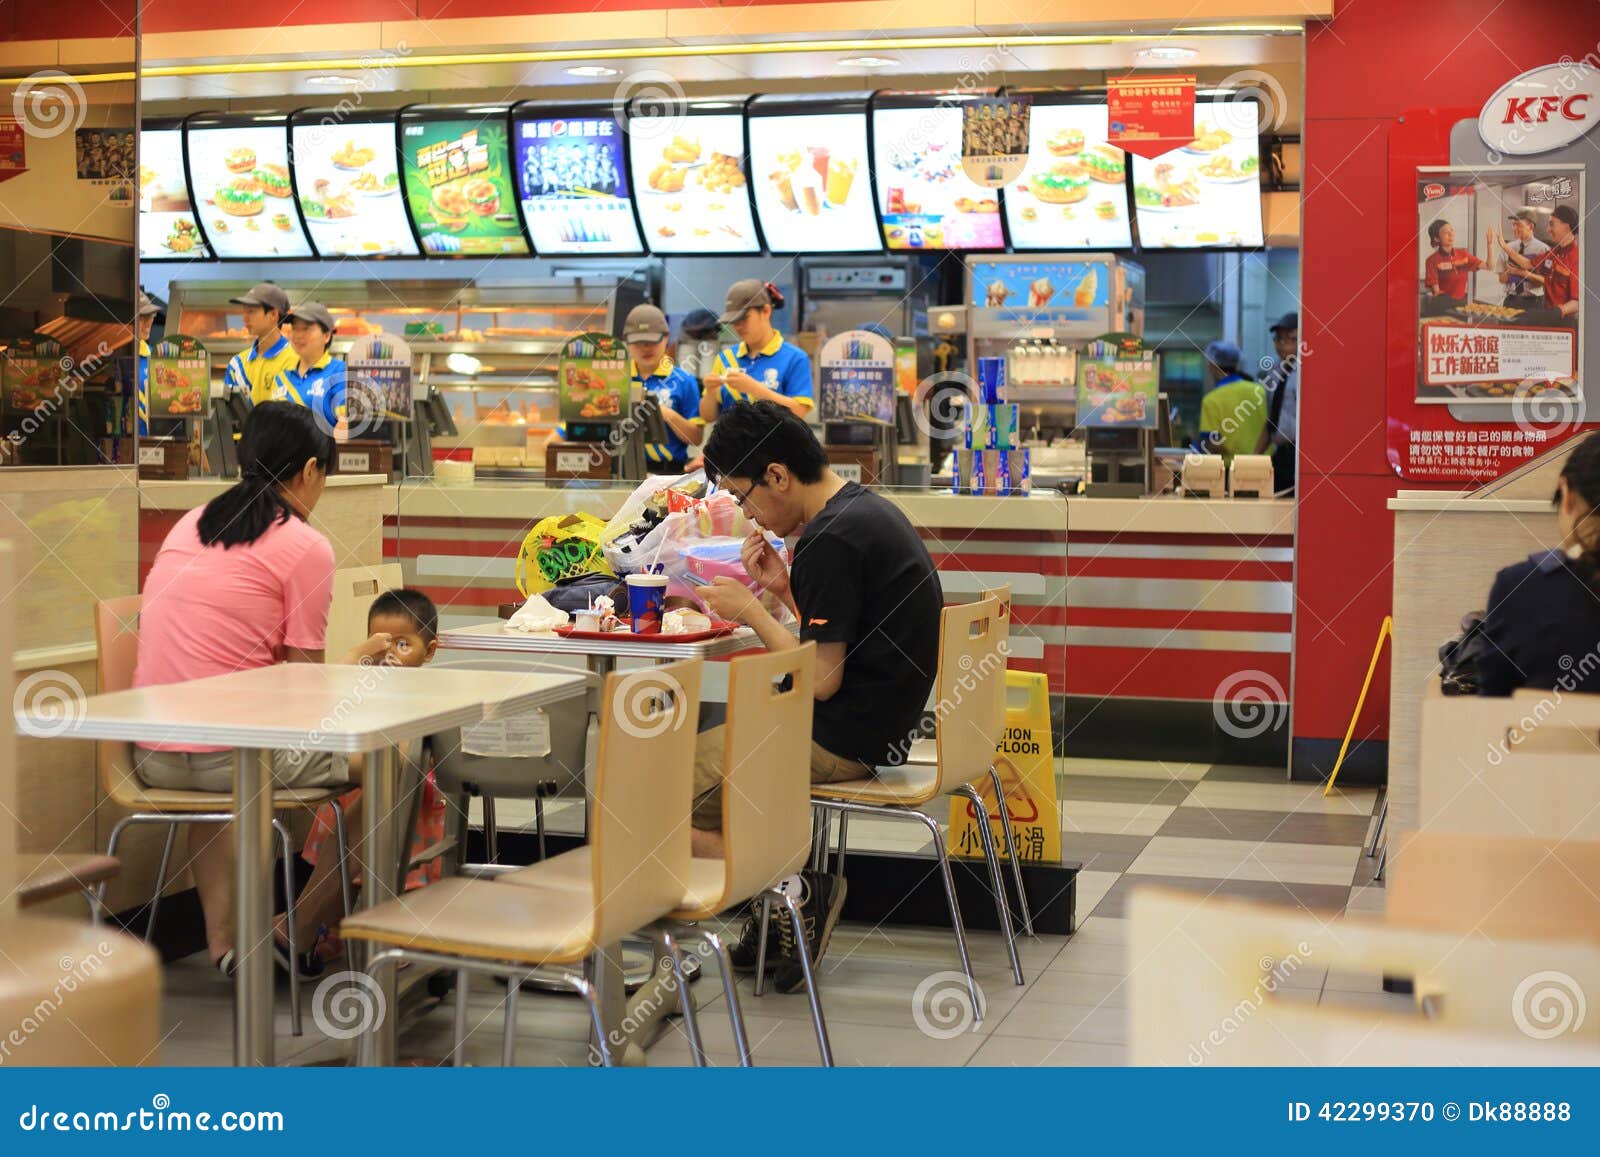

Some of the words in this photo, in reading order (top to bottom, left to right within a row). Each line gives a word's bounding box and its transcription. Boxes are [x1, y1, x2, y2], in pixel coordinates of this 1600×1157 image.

[1501, 94, 1591, 124] KFC
[1430, 333, 1499, 354] 快乐大家庭
[1430, 355, 1499, 375] 工作新起点
[1409, 430, 1547, 443] 请您保管好自己的随身物品
[1409, 444, 1534, 457] 请勿饮用非本餐厅的食物
[960, 823, 1044, 861] 小地滑
